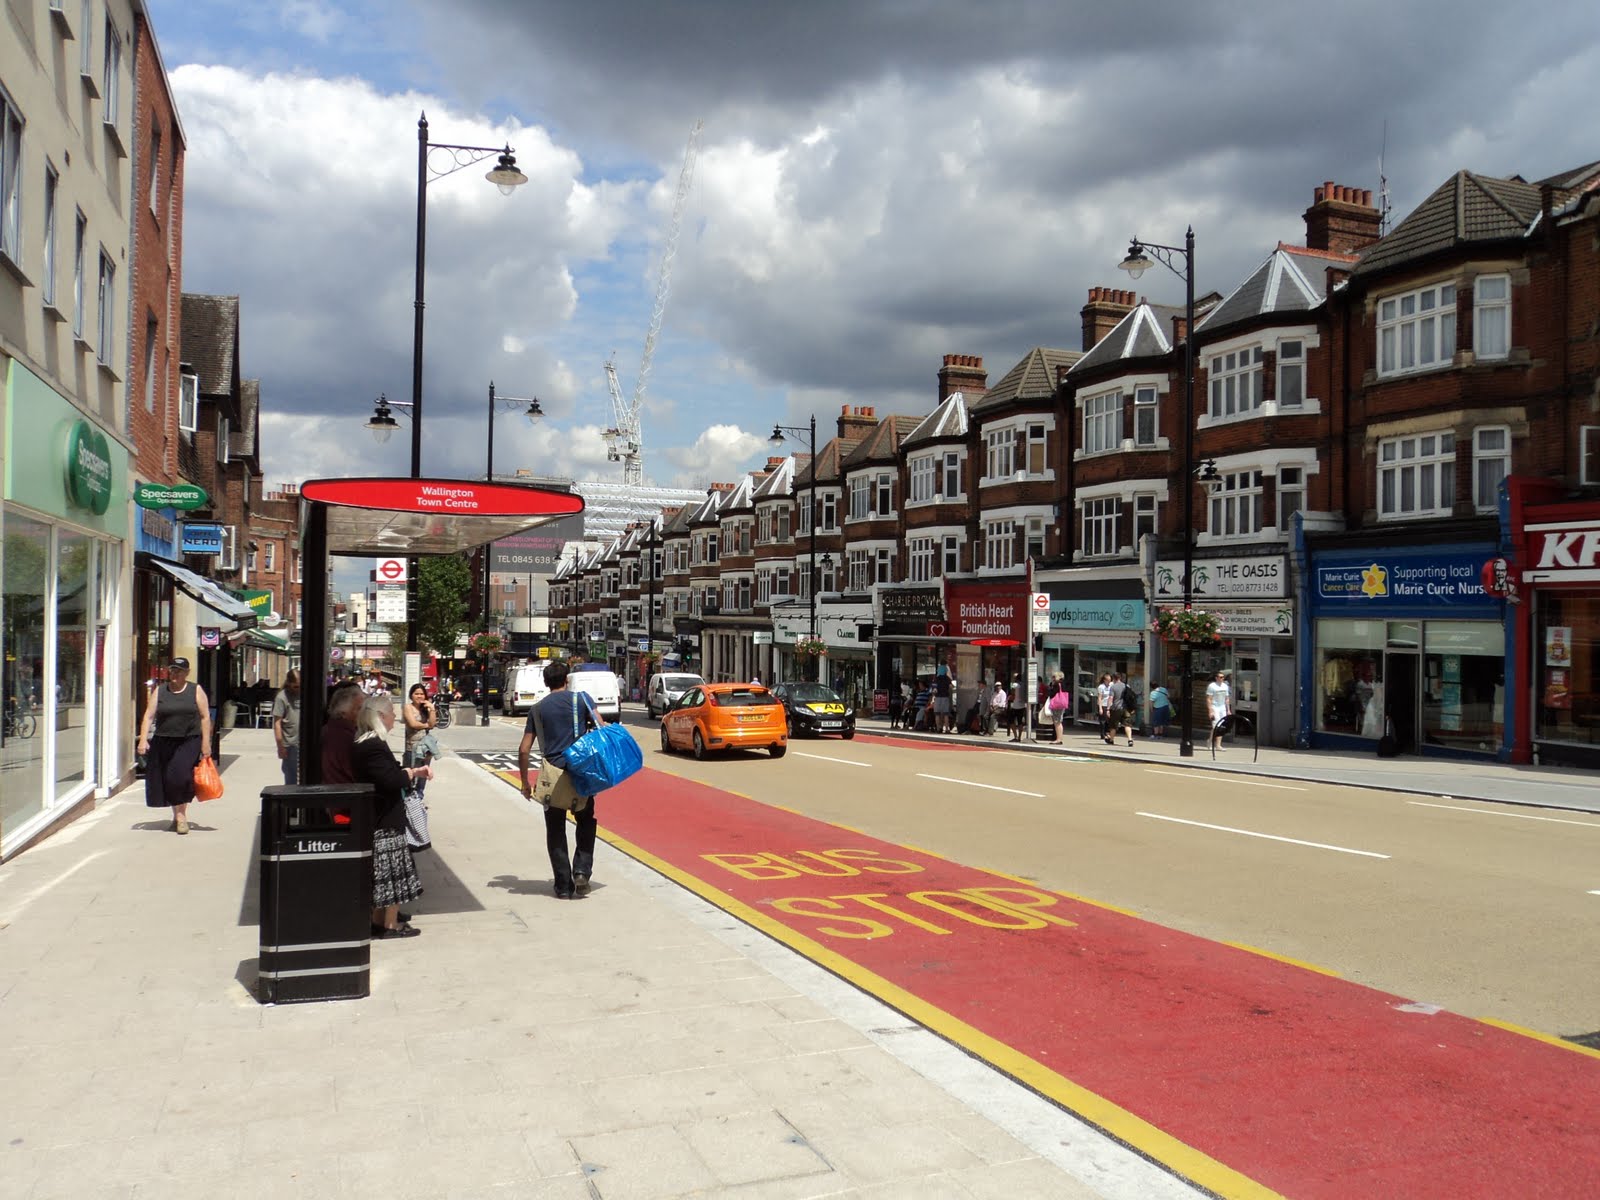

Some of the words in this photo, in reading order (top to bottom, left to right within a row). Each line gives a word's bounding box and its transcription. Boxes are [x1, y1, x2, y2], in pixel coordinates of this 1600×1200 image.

[141, 489, 199, 499] Specsavers
[422, 486, 474, 498] Wallington
[416, 496, 442, 506] Town
[445, 498, 478, 508] Centre
[184, 538, 219, 546] NERO
[497, 555, 511, 563] TEL
[512, 555, 533, 564] 0845
[535, 556, 551, 564] 638
[1216, 564, 1239, 578] THE
[1242, 564, 1278, 578] OASIS
[1325, 572, 1342, 581] Marie
[1343, 572, 1360, 581] Curie
[1394, 565, 1447, 580] Supporting
[1450, 564, 1473, 577] local
[1232, 584, 1244, 592] 020
[1245, 583, 1261, 592] 8773
[1262, 583, 1278, 592] 1428
[1323, 583, 1344, 591] Cancer
[1345, 582, 1360, 591] Care
[1394, 583, 1424, 595] Marie
[1426, 582, 1455, 594] Curie
[1458, 582, 1486, 595] Nurs
[960, 603, 987, 618] British
[988, 603, 1014, 618] Heart
[1050, 608, 1114, 625] oydspharmacy
[961, 621, 1011, 635] Foundation
[824, 703, 844, 711] AA
[298, 840, 337, 852] Litter
[698, 848, 927, 880] BUS
[771, 887, 1079, 940] STOP
